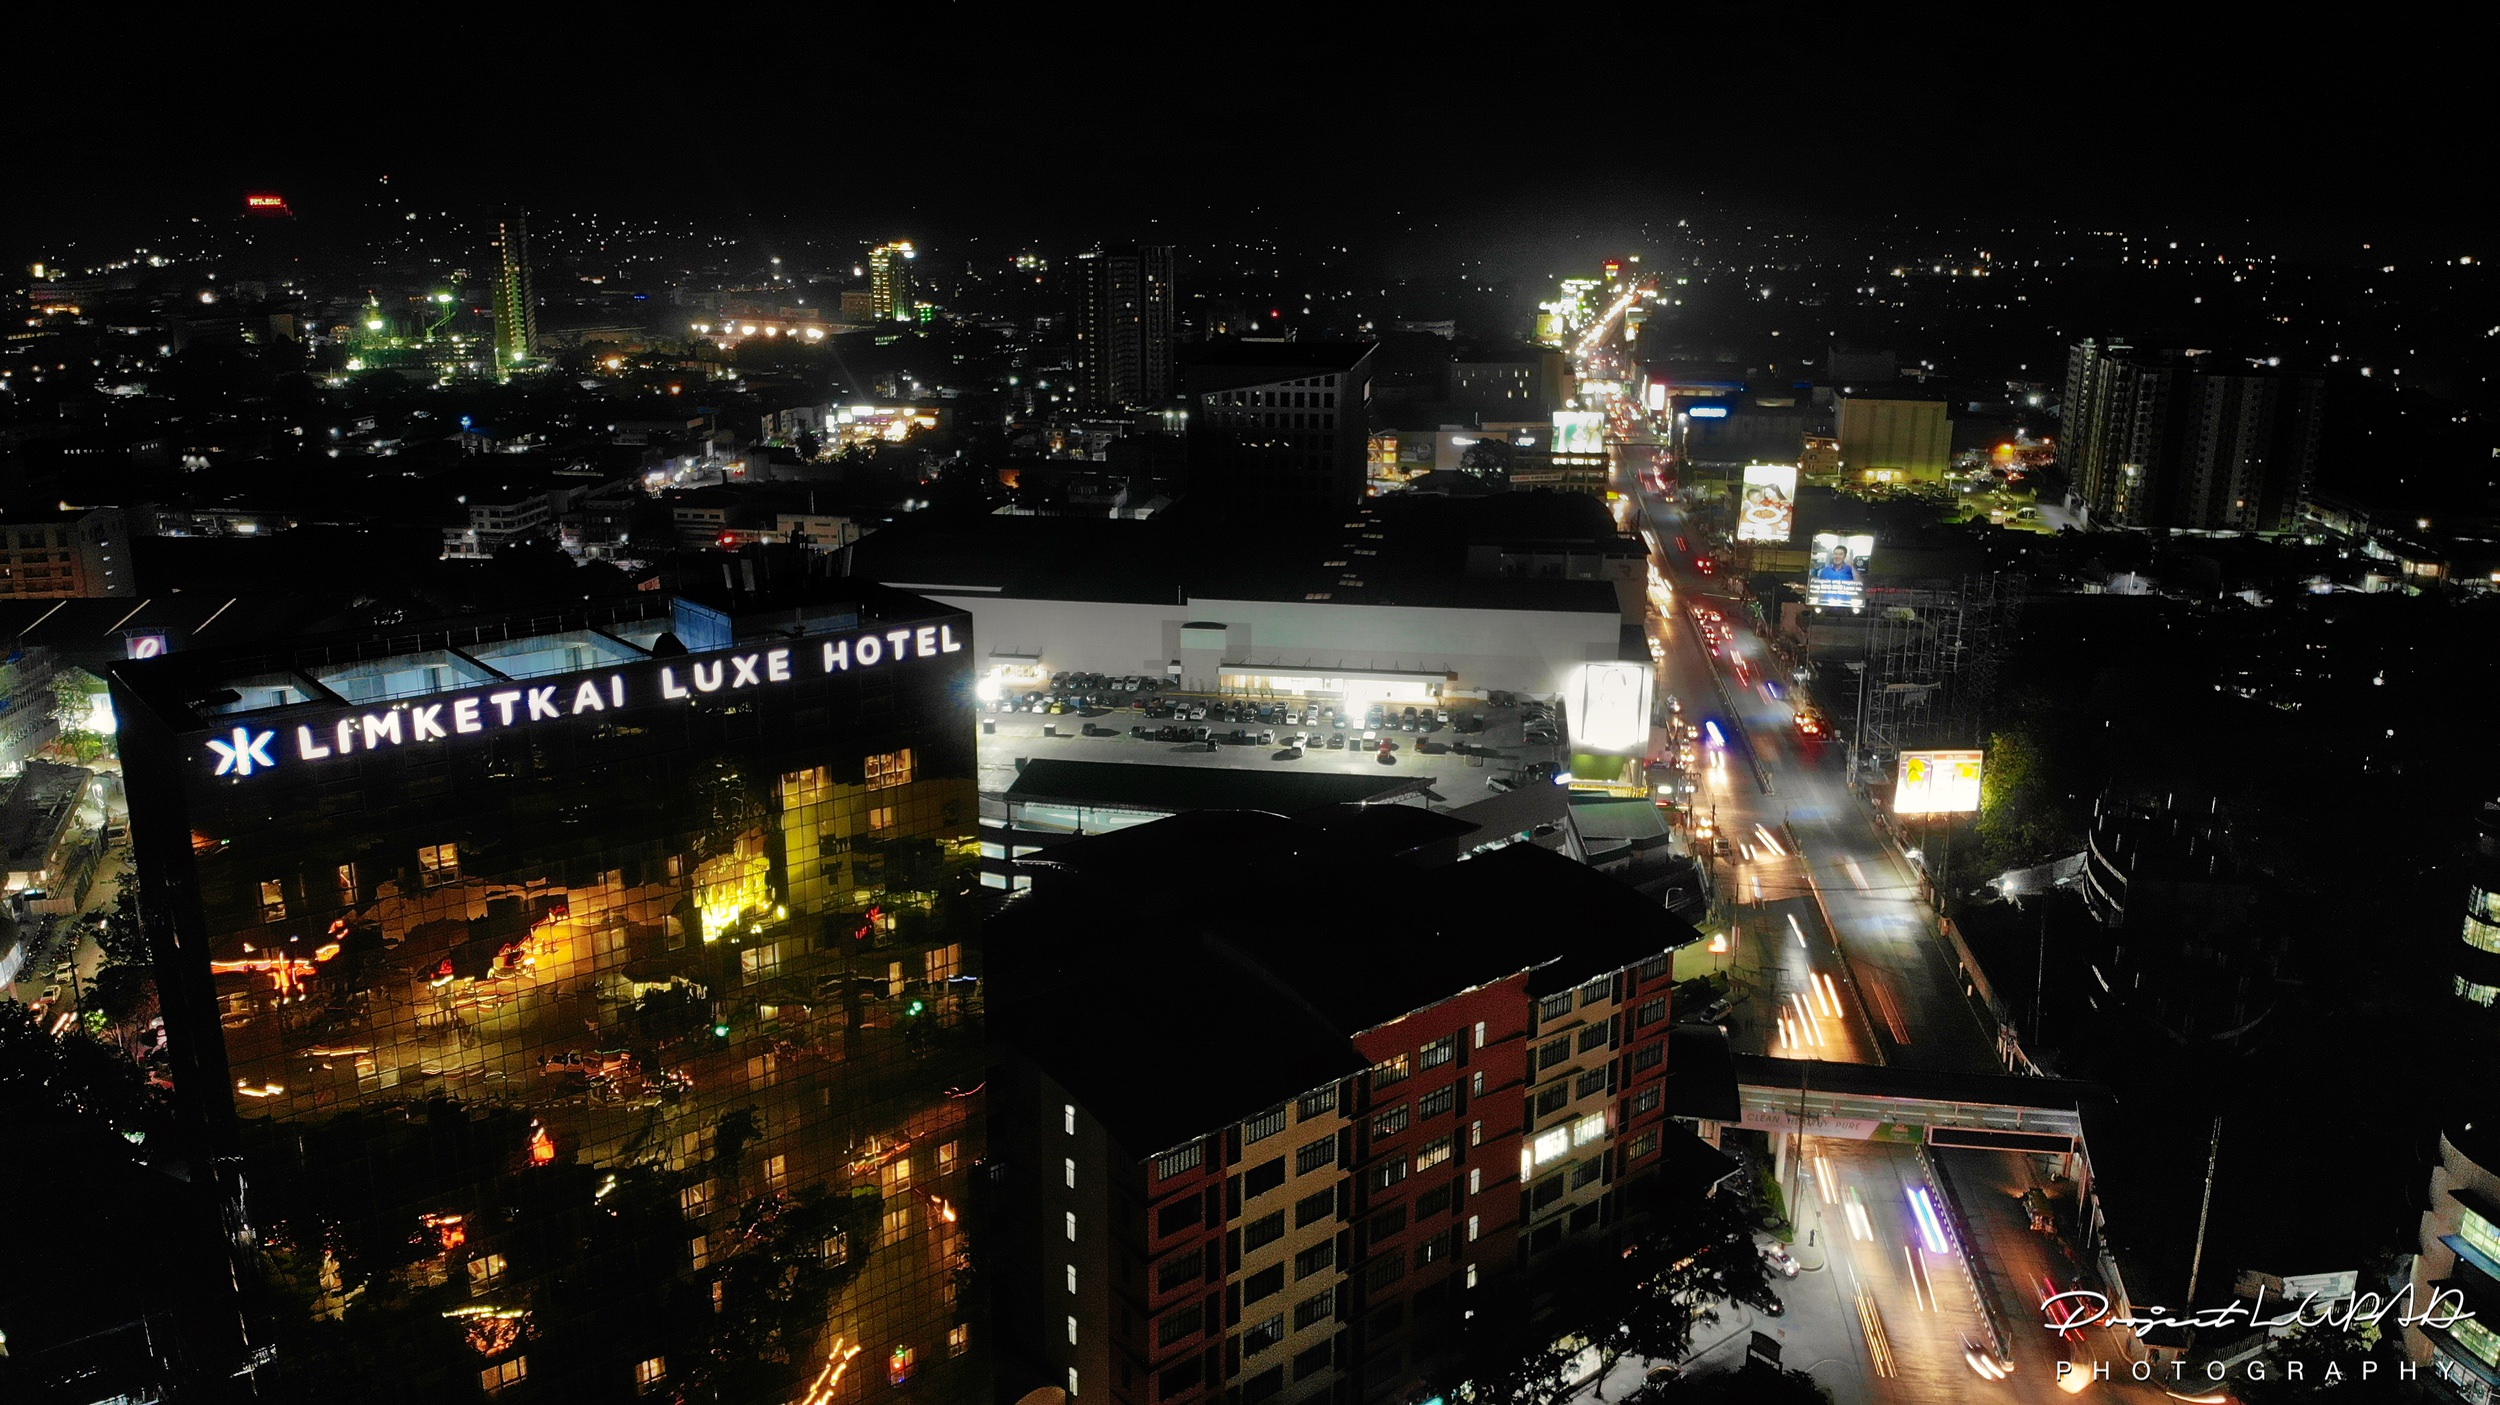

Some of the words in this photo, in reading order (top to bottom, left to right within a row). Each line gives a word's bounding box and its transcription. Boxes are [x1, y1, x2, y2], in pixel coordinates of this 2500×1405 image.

[298, 675, 625, 761] LIMKETKAI
[661, 649, 791, 700] LUXE
[822, 625, 962, 673] HOTEL
[1746, 1113, 1780, 1123] CLEAN
[1836, 1121, 1861, 1131] PURE
